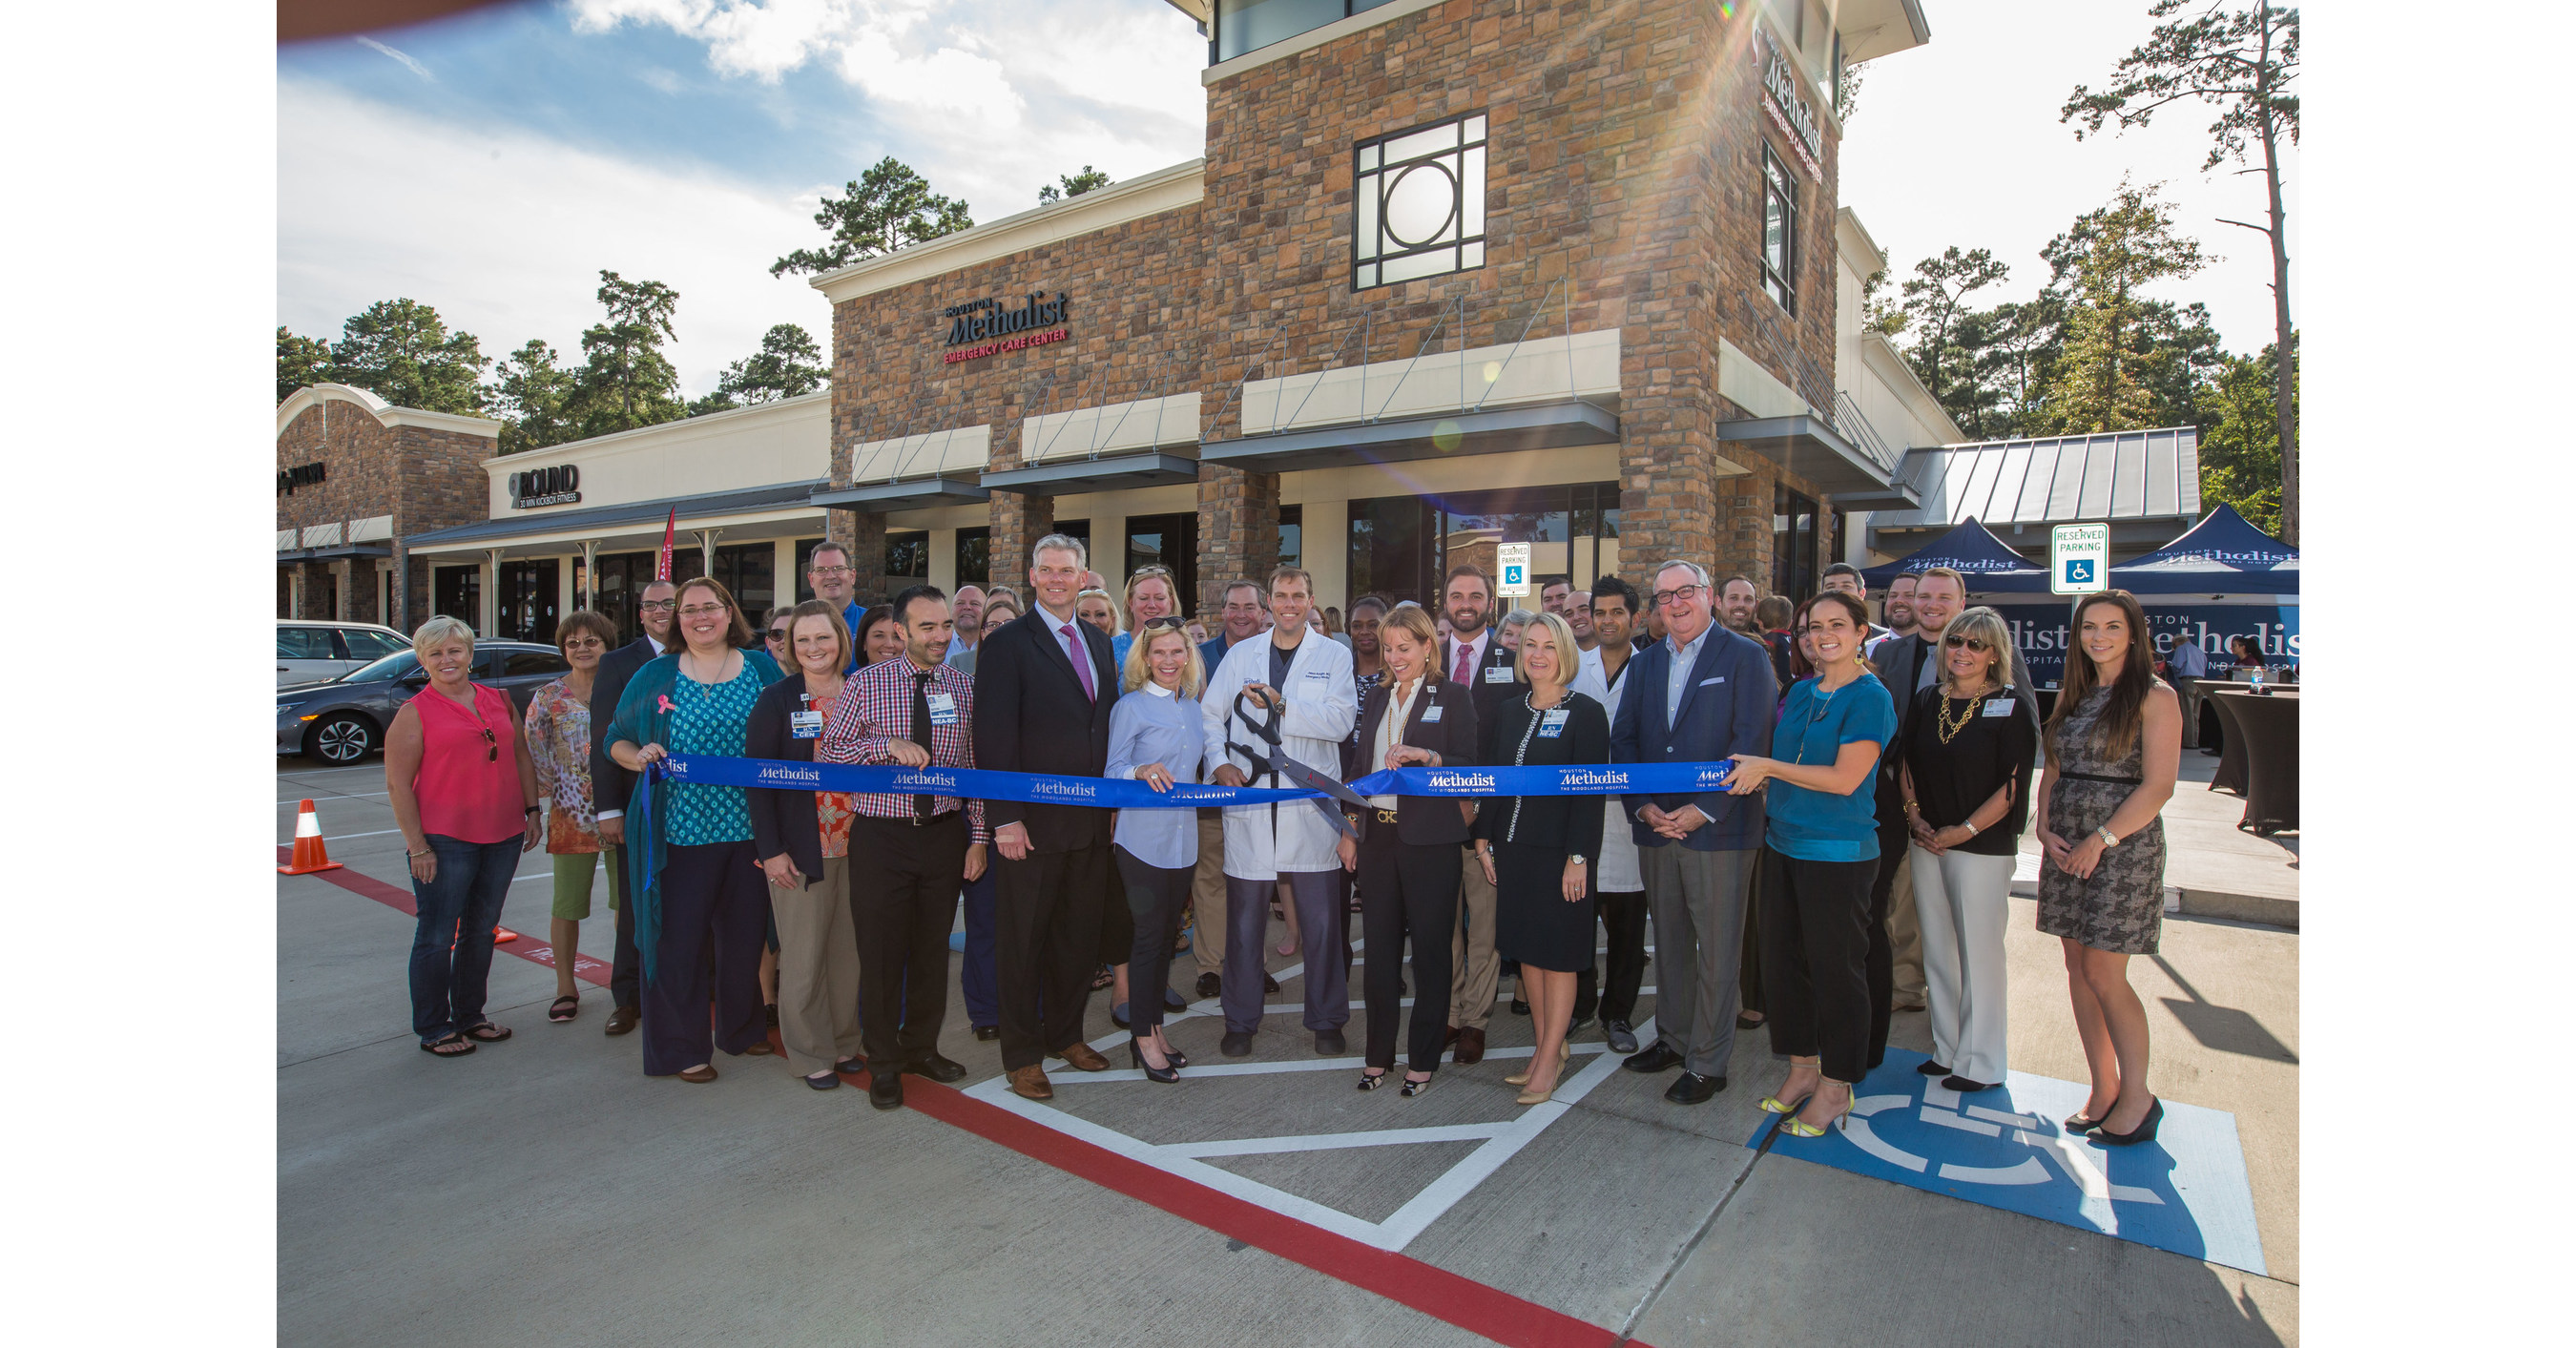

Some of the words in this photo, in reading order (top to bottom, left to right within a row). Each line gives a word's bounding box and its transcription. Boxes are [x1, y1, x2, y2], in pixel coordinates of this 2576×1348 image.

[1764, 57, 1823, 165] Methodist
[1805, 156, 1822, 186] CENTER
[944, 297, 993, 318] HOUSTON
[944, 290, 1068, 346] Methodist
[944, 343, 999, 364] EMERGENCY
[1001, 337, 1028, 353] CARE
[1028, 329, 1068, 347] CENTER
[519, 500, 526, 508] 30
[526, 498, 536, 508] MIN
[535, 495, 557, 507] KICKBOX
[556, 492, 577, 504] FITNESS
[2057, 529, 2105, 541] RESERVED
[1500, 548, 1528, 556] RESERVED
[2060, 542, 2101, 552] PARKING
[2156, 549, 2211, 557] HOUSTON
[1502, 556, 1527, 565] PARKING
[1904, 558, 2017, 570] Methodist
[2159, 550, 2298, 564] Methodist
[2144, 615, 2190, 625] STON
[2148, 621, 2299, 657] ethodis
[758, 767, 821, 781] Methodist
[893, 772, 957, 787] Methodist
[1428, 773, 1496, 787] Methodist
[1561, 772, 1630, 785] Methodist
[1031, 781, 1096, 797] Methodist
